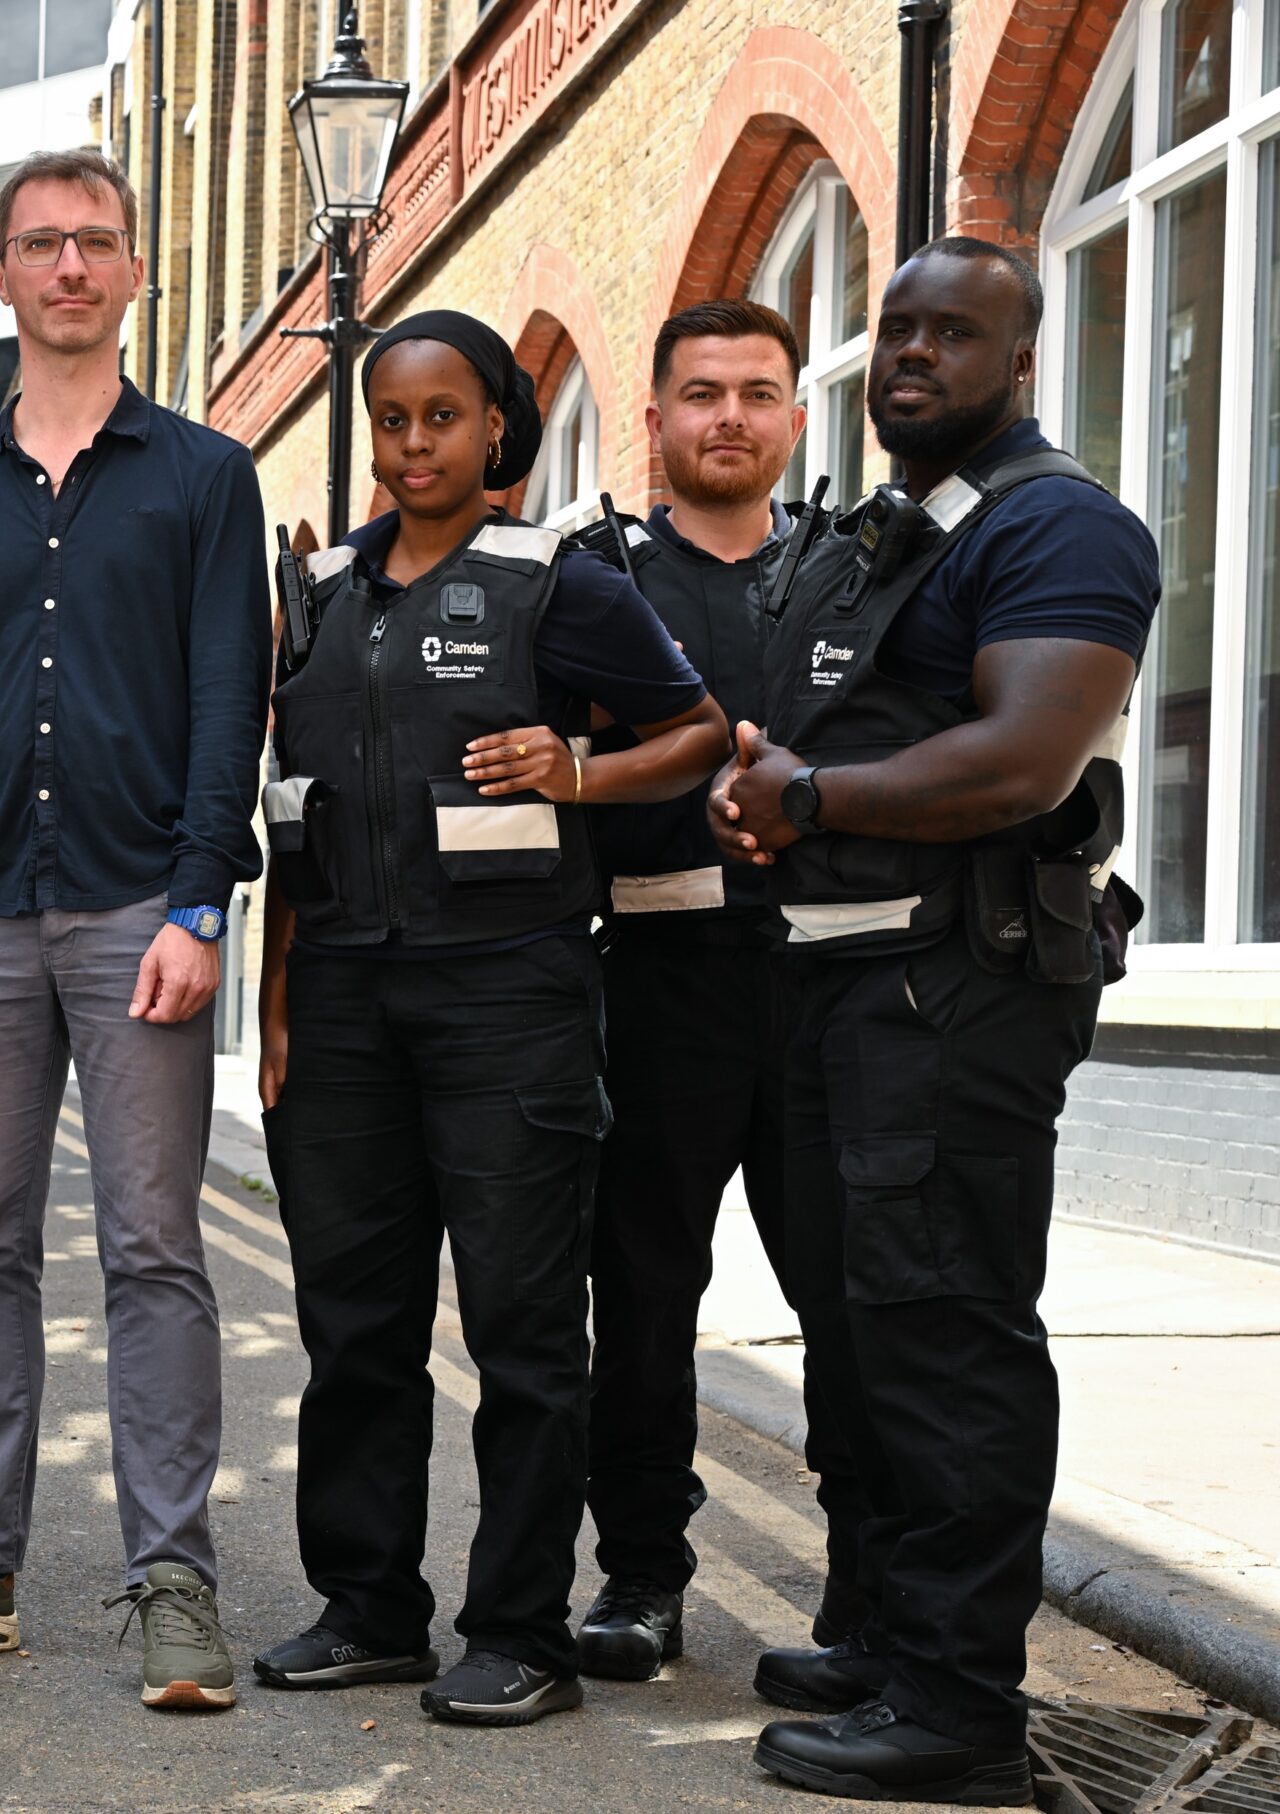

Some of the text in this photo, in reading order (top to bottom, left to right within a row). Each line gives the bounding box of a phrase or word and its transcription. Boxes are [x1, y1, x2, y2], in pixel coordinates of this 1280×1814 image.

[462, 0, 606, 176] WESTMINST
[445, 640, 489, 655] Camden
[824, 645, 854, 661] Camden
[426, 665, 485, 674] Community Safety
[435, 671, 476, 679] Enforcement
